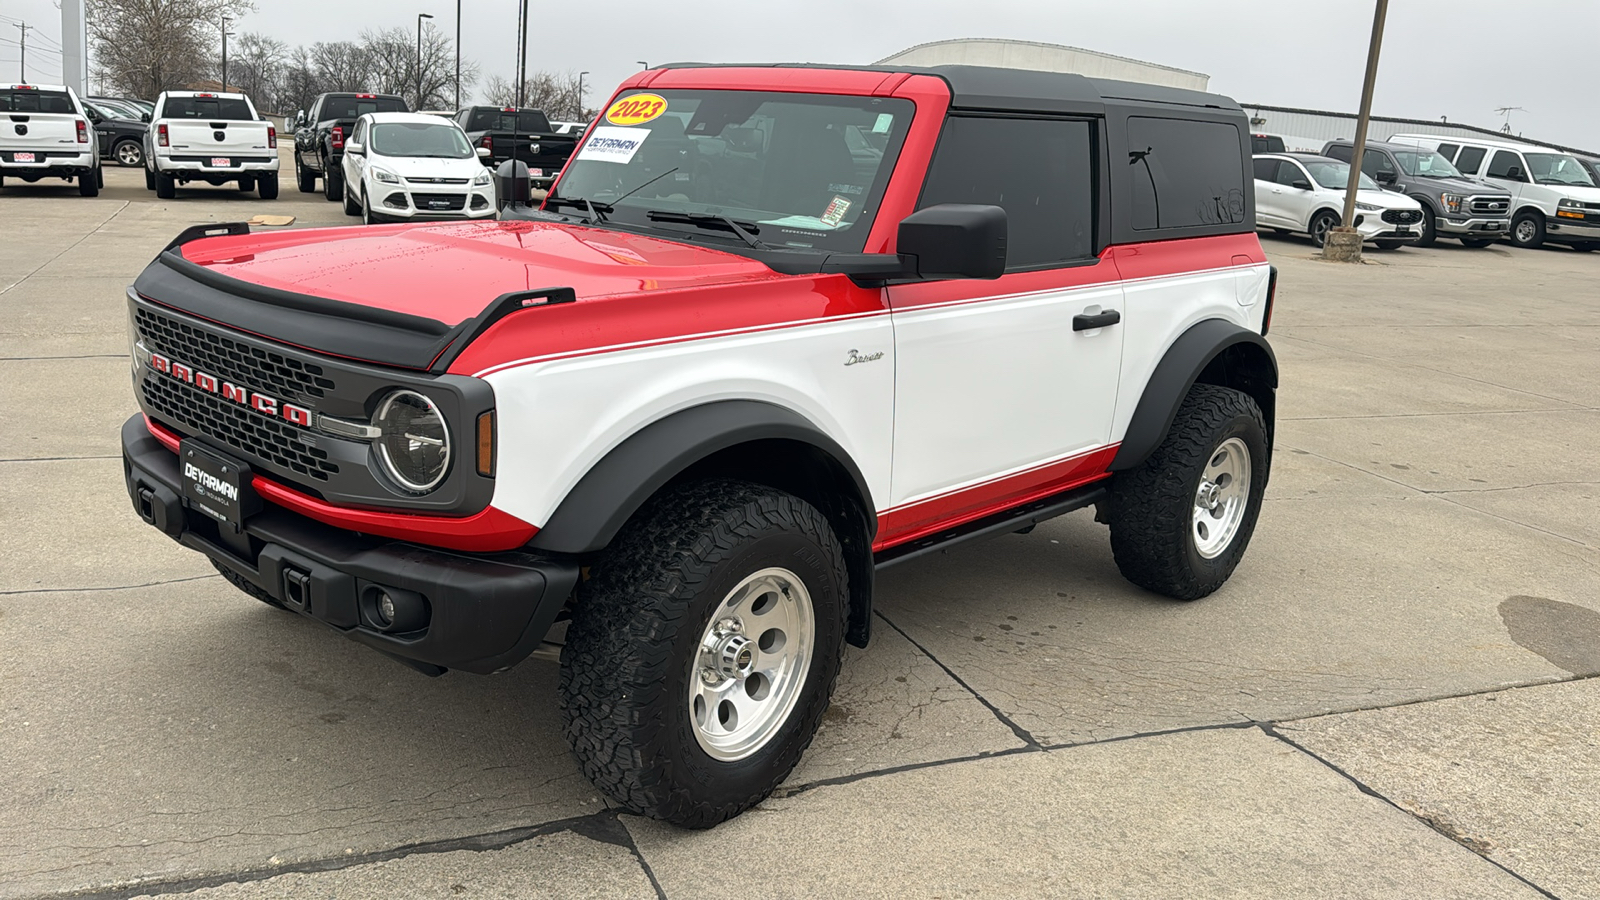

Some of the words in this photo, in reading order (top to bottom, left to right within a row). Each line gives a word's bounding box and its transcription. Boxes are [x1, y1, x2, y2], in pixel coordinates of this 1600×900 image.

[609, 100, 664, 119] 2023
[588, 138, 639, 150] DEYARMAN
[152, 353, 312, 427] BRONCO
[184, 462, 238, 501] DEYARMAN
[206, 491, 230, 507] INDIANOLA
